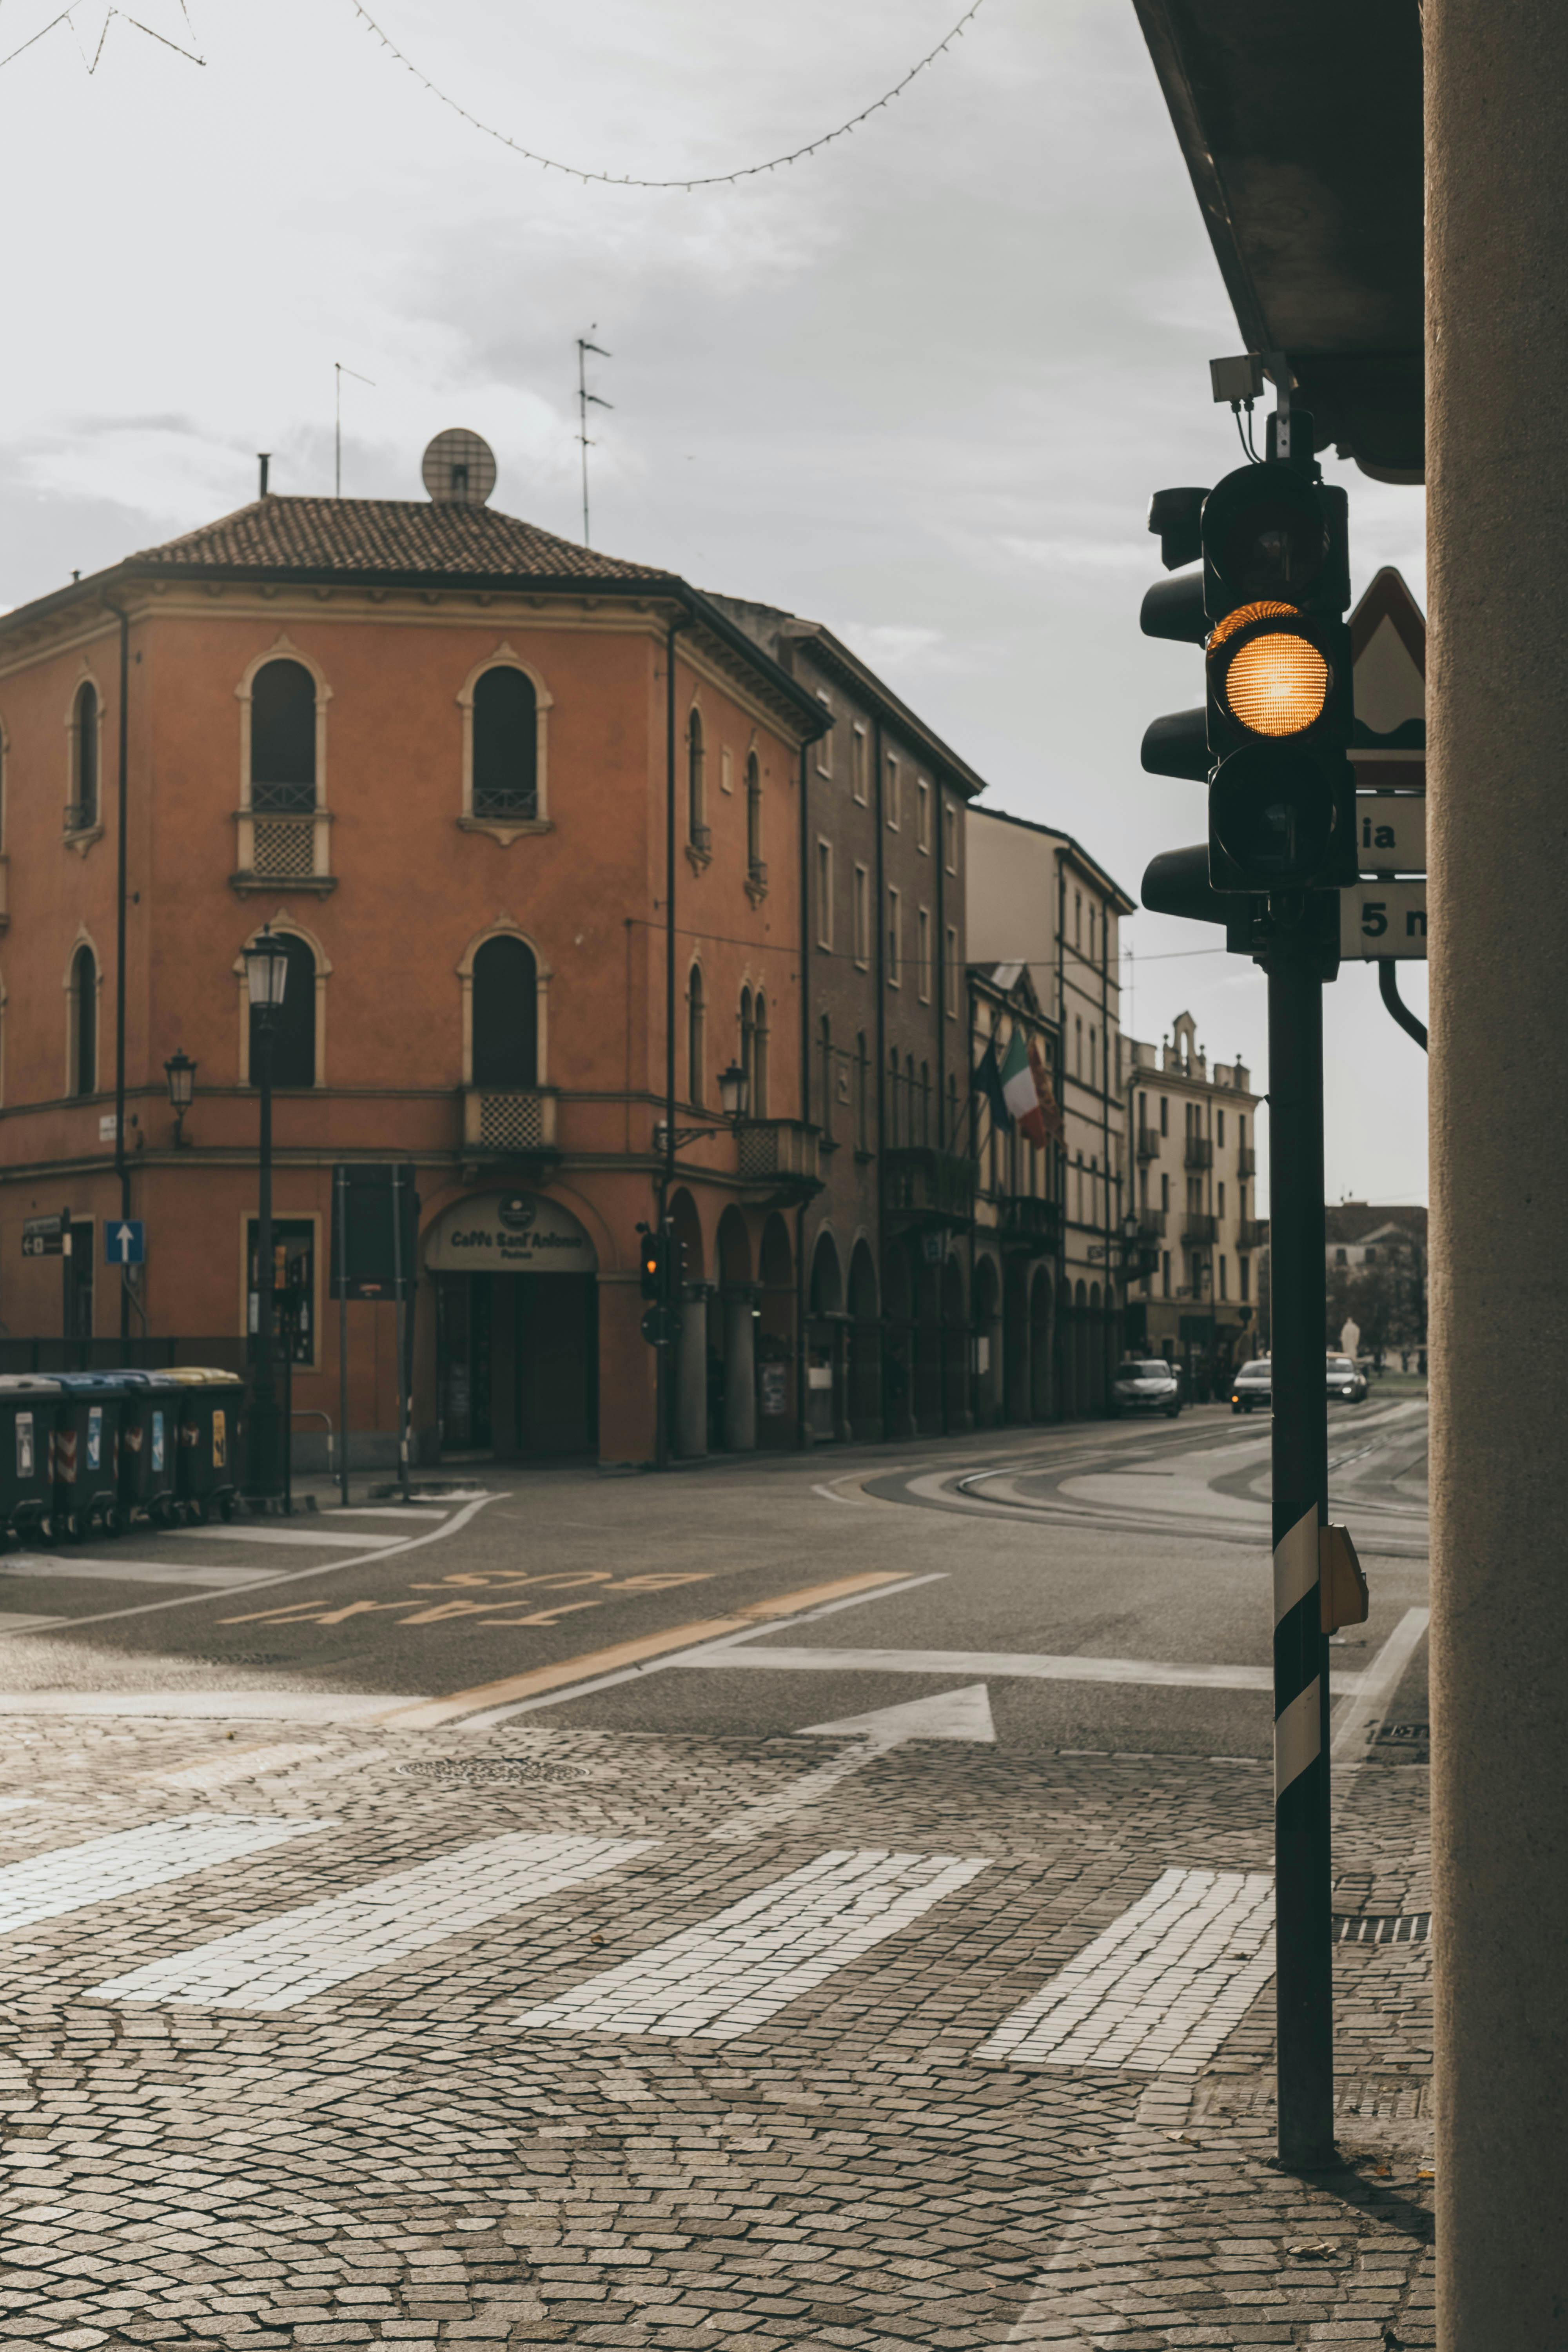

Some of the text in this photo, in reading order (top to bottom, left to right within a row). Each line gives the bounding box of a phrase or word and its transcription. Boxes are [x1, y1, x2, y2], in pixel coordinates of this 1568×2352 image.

[1363, 817, 1396, 848] ia
[1361, 902, 1388, 937] 5
[408, 1570, 717, 1590] BUS
[214, 1600, 603, 1625] TAXI
